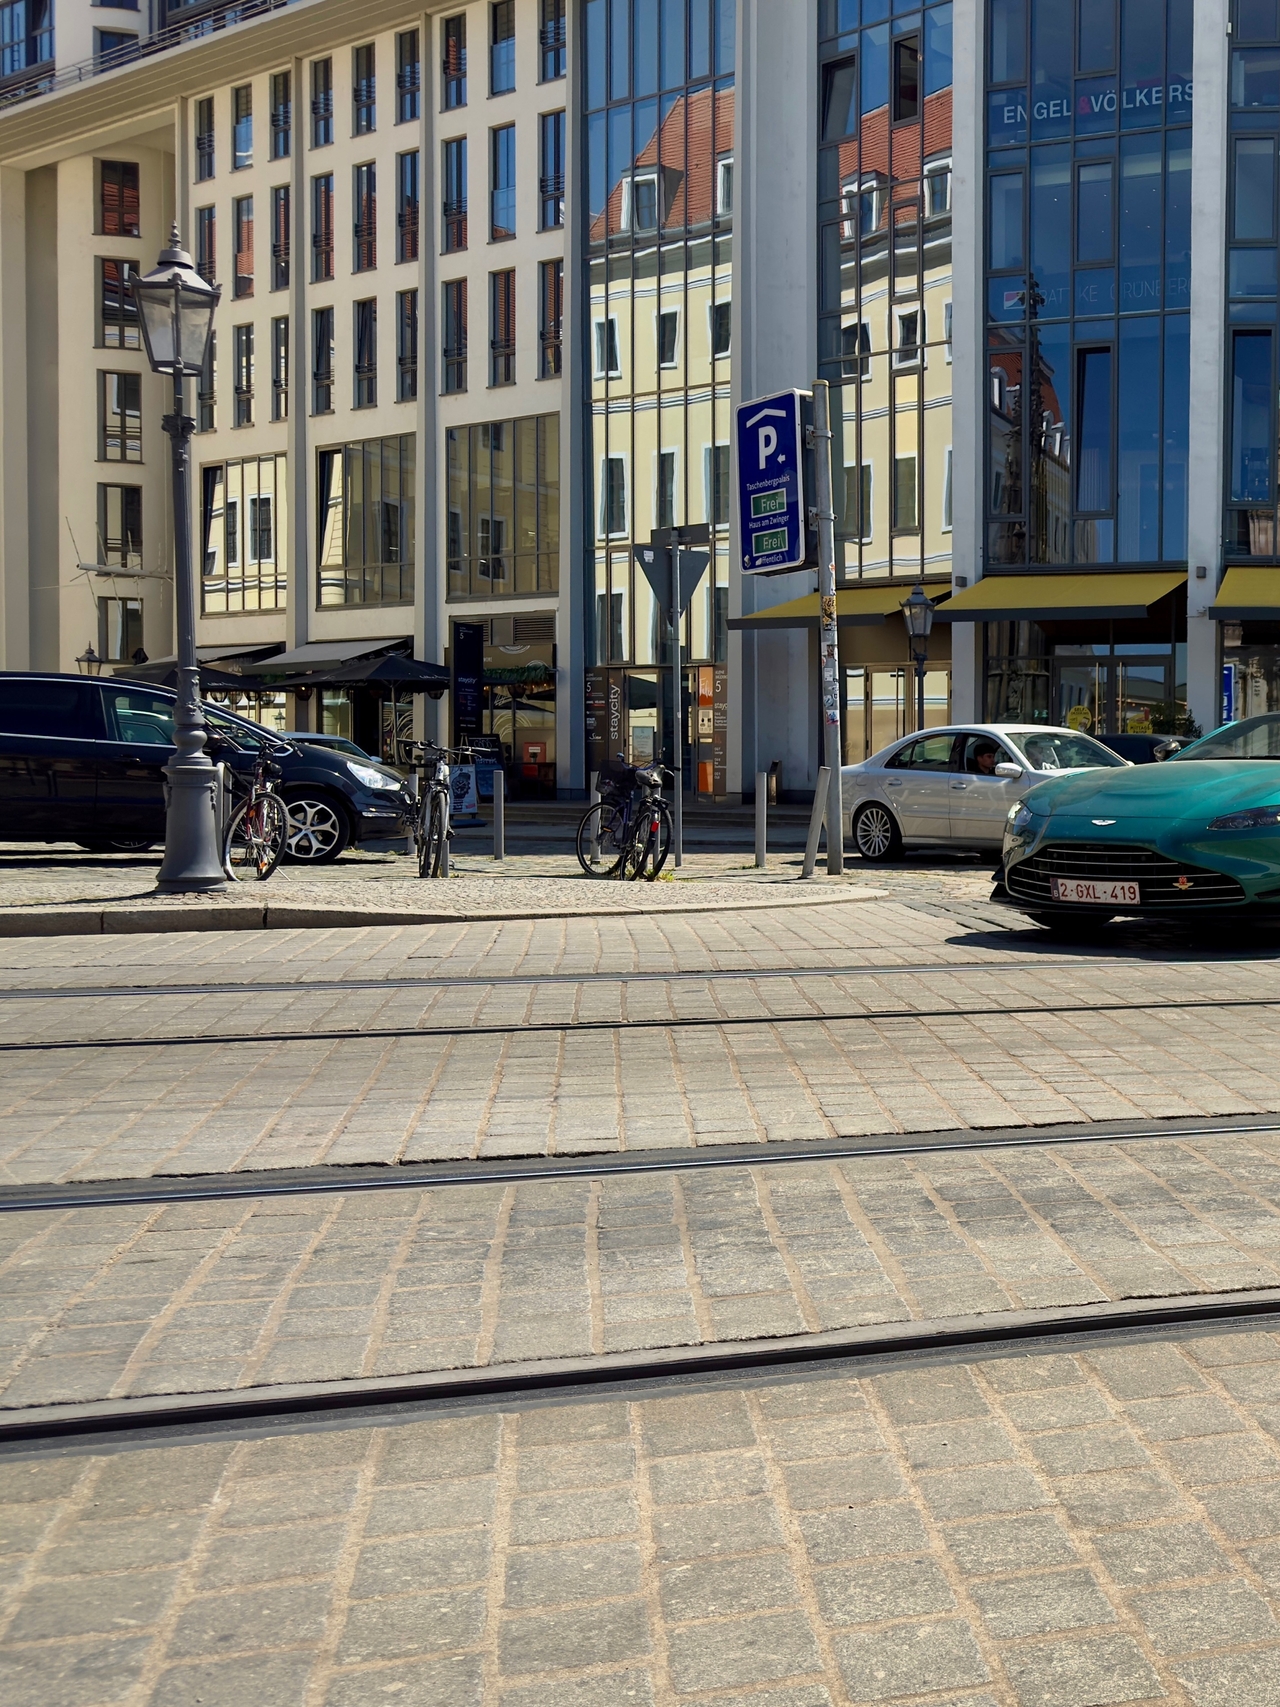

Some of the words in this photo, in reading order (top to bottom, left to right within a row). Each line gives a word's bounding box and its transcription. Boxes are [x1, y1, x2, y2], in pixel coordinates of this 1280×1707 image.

[1003, 98, 1072, 124] ENGEL
[1091, 81, 1193, 114] VÖLKERS
[758, 425, 778, 470] P
[746, 474, 790, 490] Taschenbergpalais
[761, 495, 779, 512] Frei
[749, 519, 761, 530] Haus
[761, 519, 770, 527] am
[770, 514, 790, 526] Zwinger
[763, 536, 781, 551] Frei
[757, 553, 783, 566] ffentlich
[586, 681, 592, 692] 5
[715, 680, 722, 693] 5
[609, 684, 620, 740] staycity
